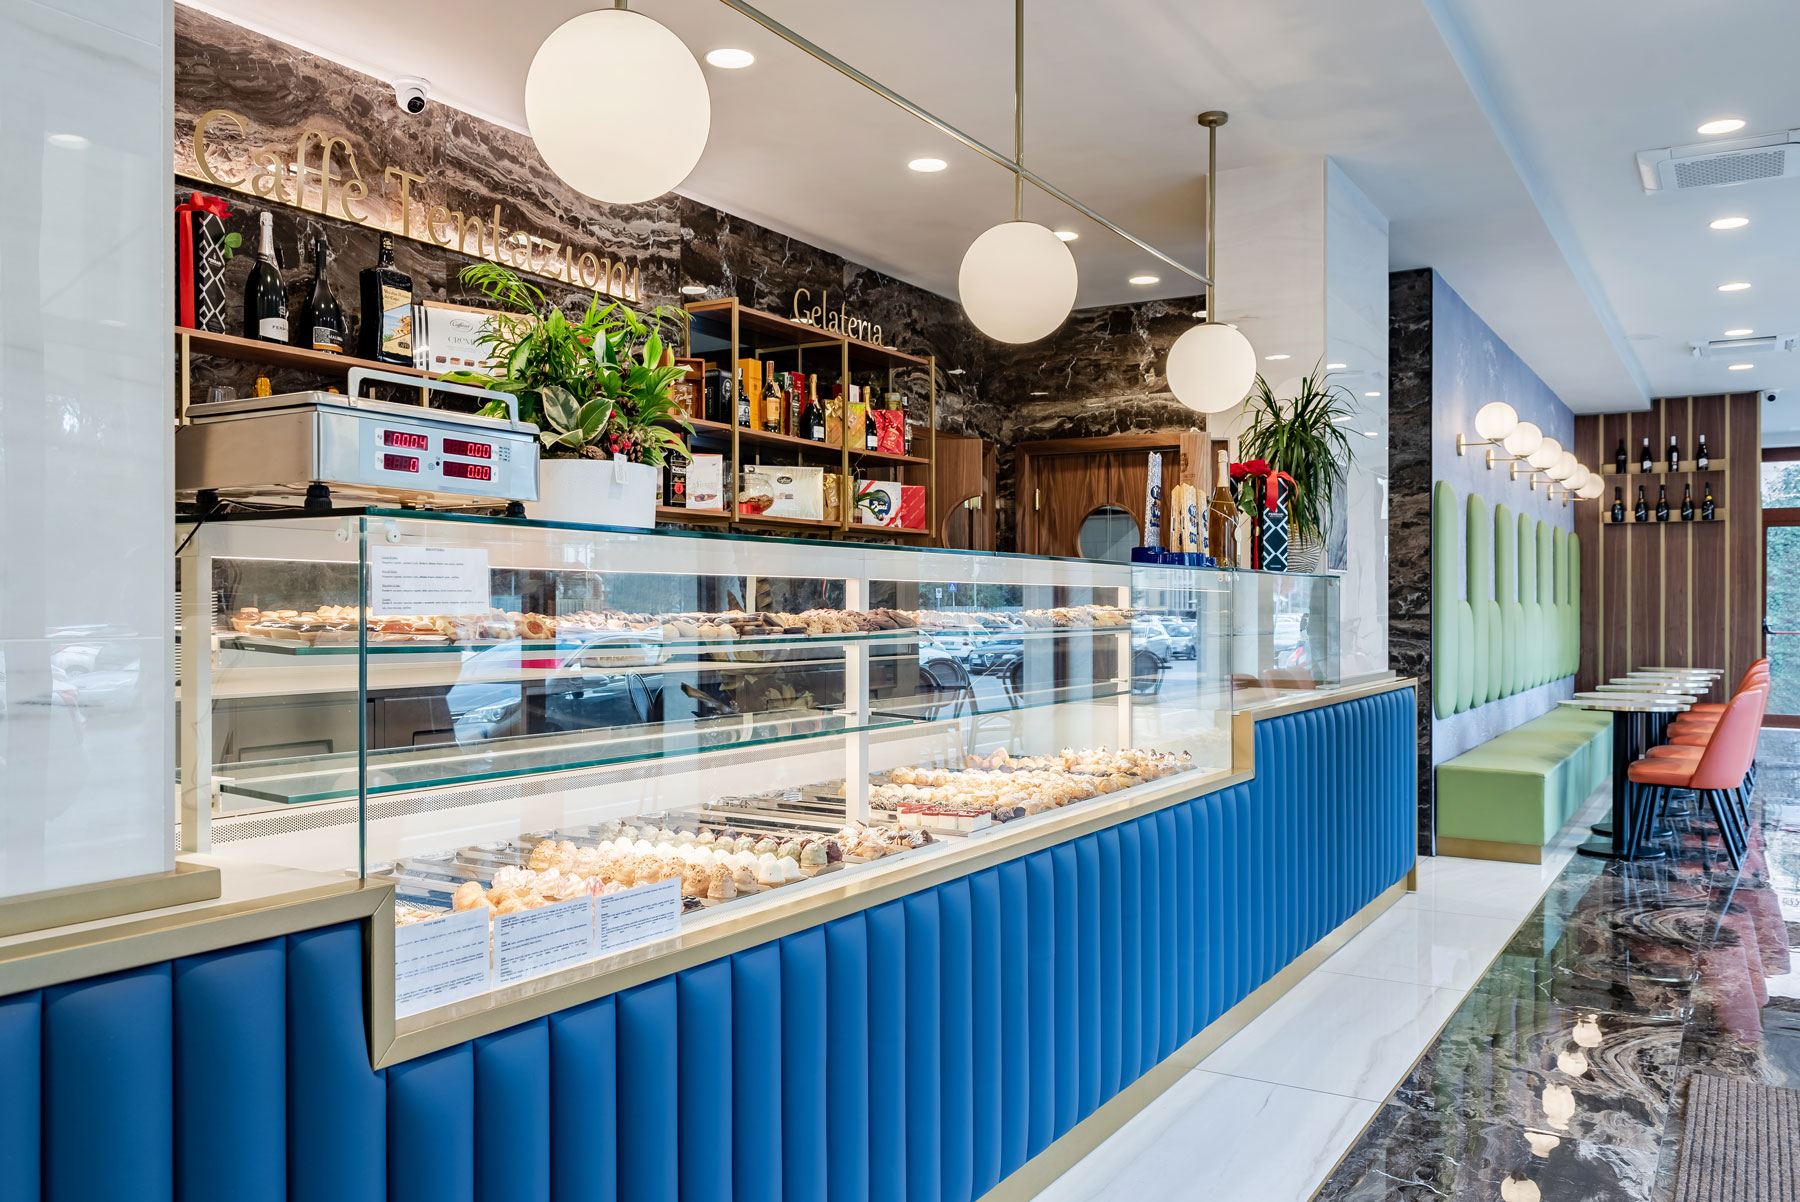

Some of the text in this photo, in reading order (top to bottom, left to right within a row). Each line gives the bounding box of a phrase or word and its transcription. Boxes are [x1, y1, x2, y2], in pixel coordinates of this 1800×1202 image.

[193, 109, 369, 223] Caffè
[793, 288, 883, 346] Gelateria
[392, 433, 427, 450] 0.004
[467, 443, 490, 458] 0.00
[409, 458, 418, 472] 0
[467, 465, 490, 480] 0.00
